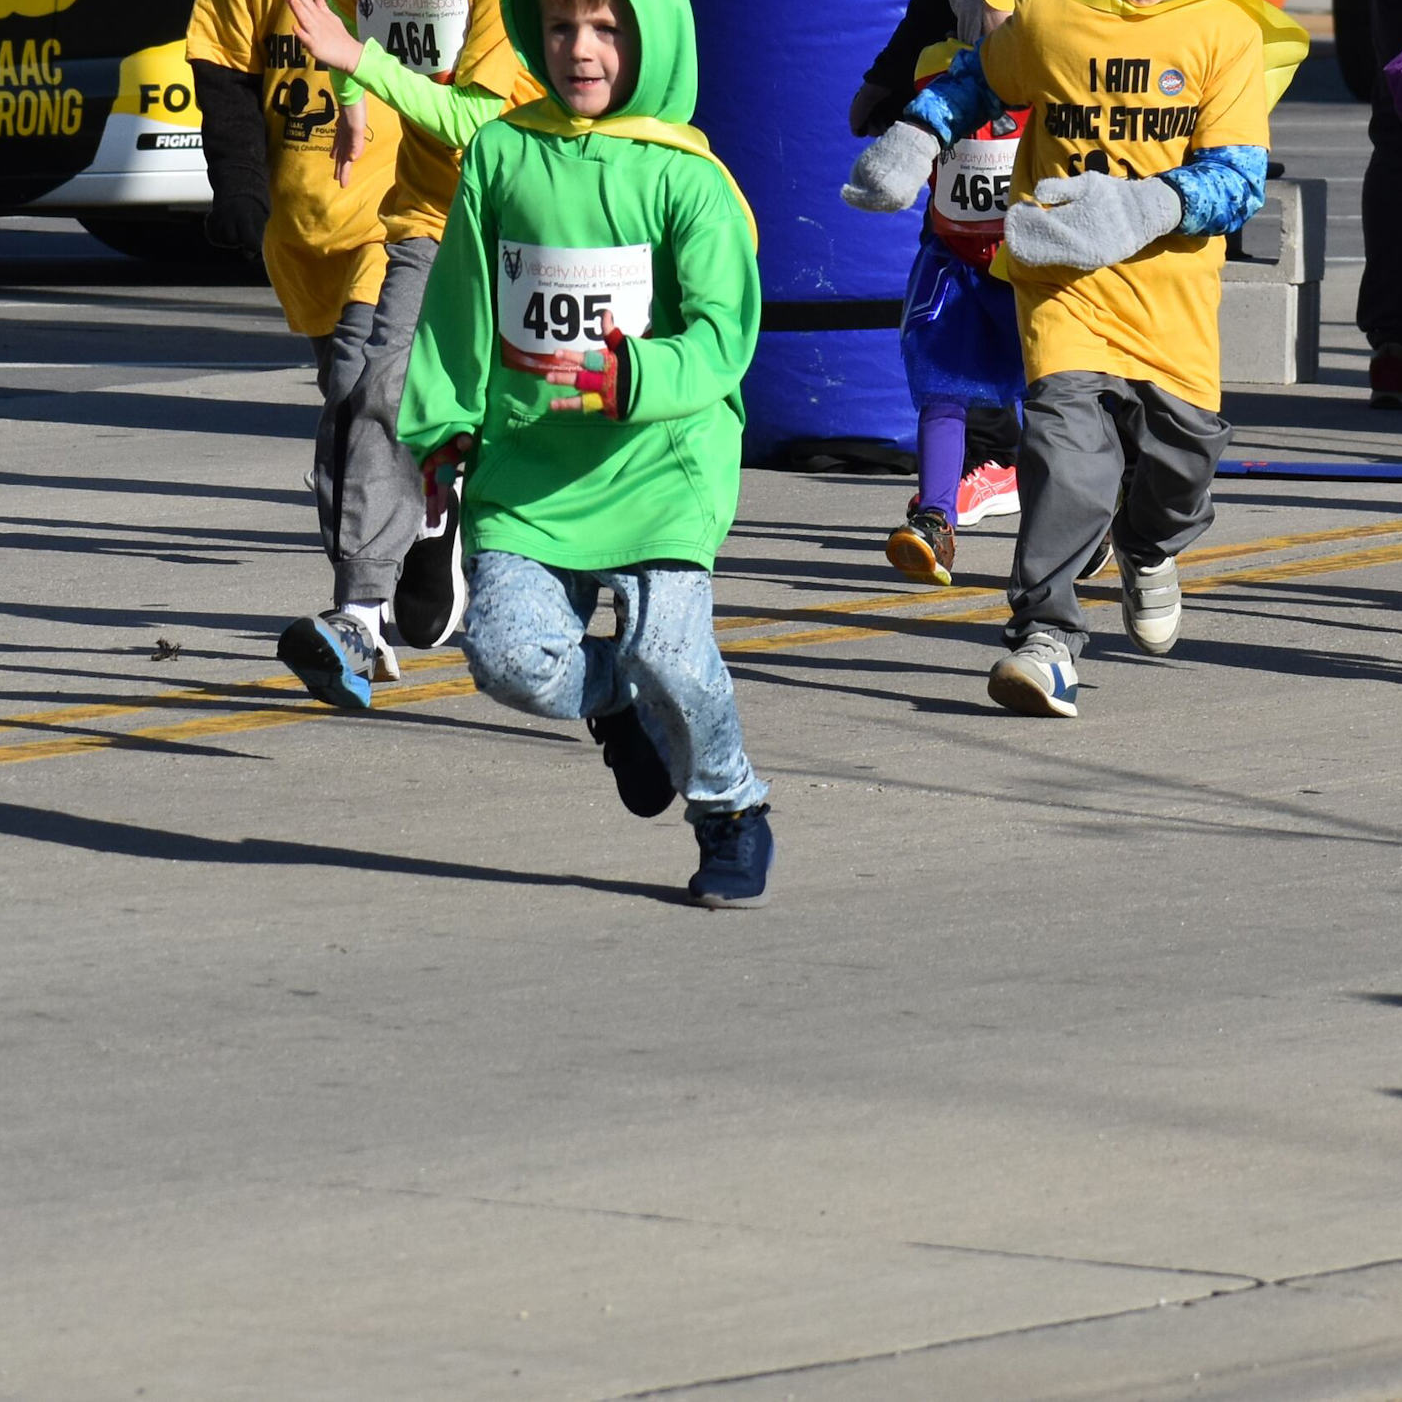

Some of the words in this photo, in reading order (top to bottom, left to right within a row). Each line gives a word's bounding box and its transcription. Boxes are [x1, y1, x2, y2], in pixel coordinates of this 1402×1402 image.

[386, 21, 441, 67] 464
[1089, 57, 1097, 93] I
[1106, 58, 1151, 94] AM
[139, 83, 191, 114] FO
[1045, 102, 1102, 140] SAAC
[950, 173, 1011, 212] 465
[523, 291, 614, 342] 495
